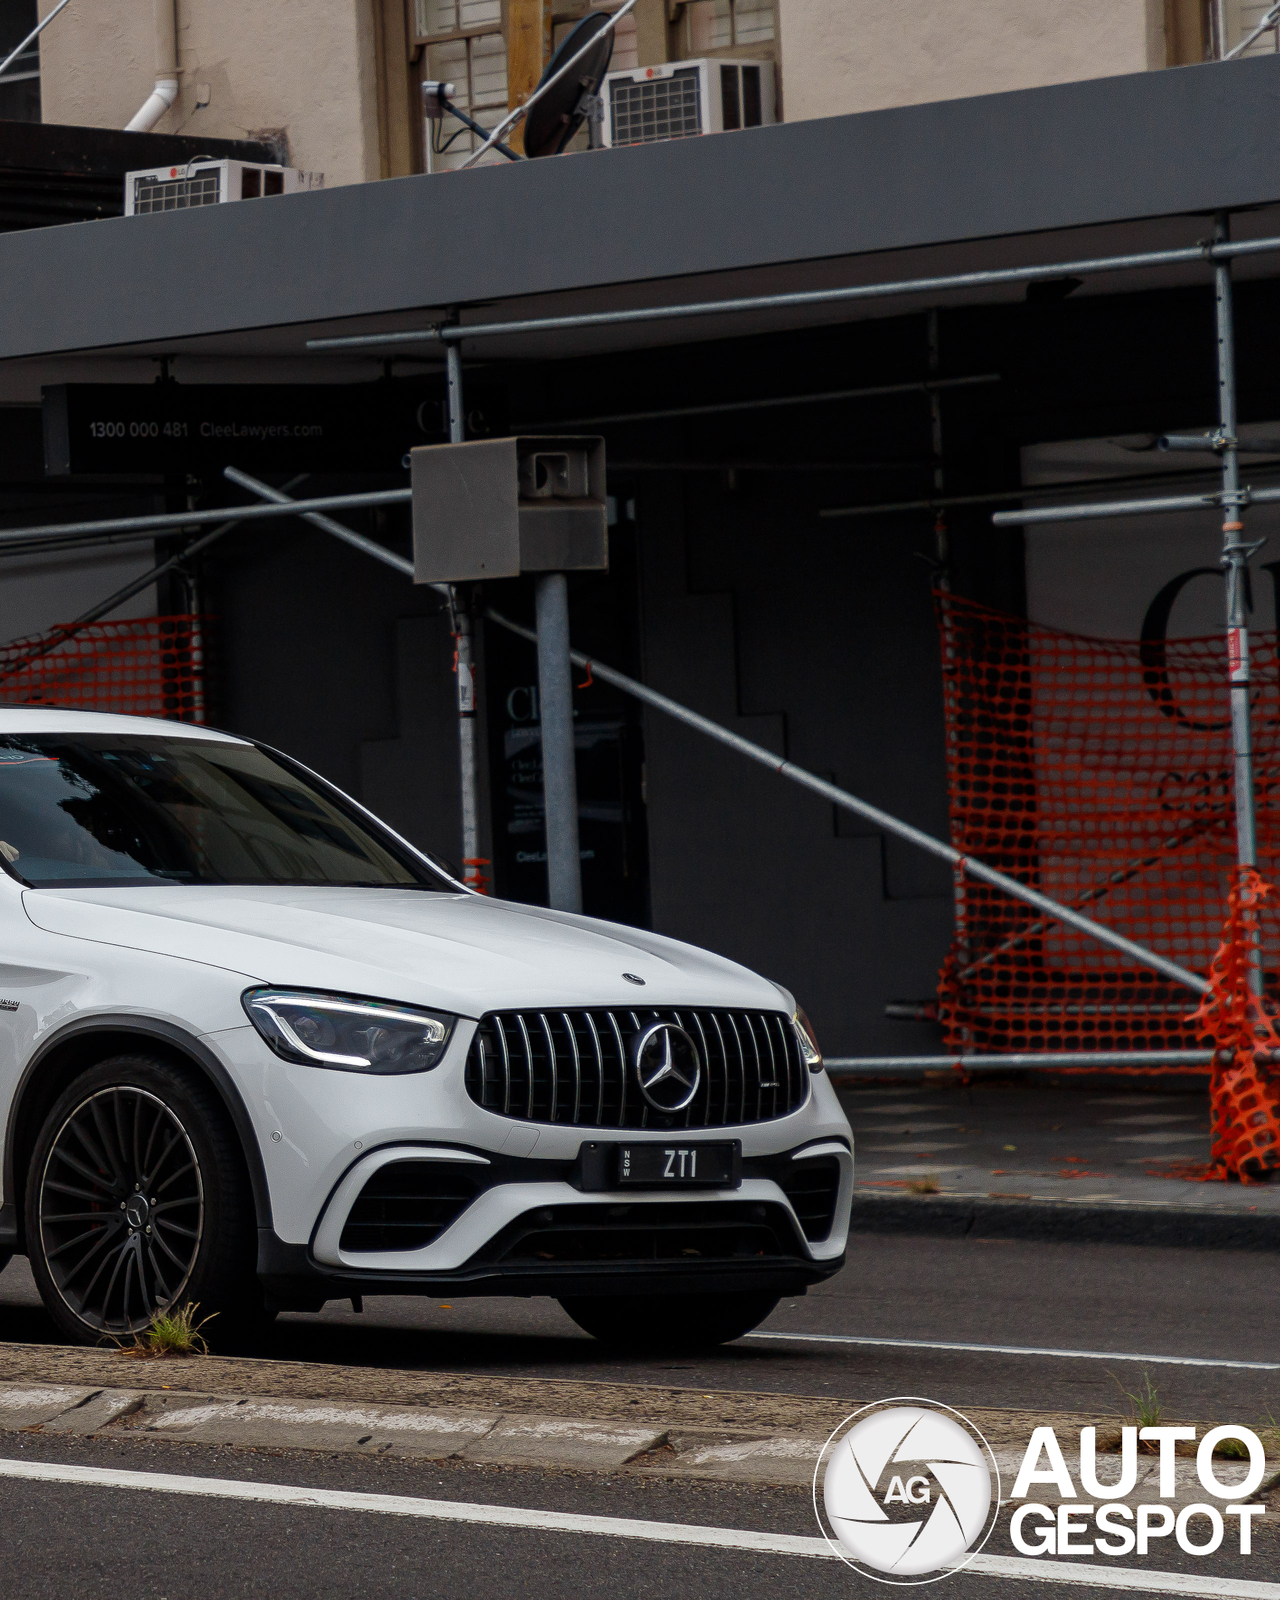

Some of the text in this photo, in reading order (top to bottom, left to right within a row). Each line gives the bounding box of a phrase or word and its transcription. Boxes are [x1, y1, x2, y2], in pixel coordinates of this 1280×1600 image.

[417, 399, 491, 434] Cle.
[89, 421, 323, 440] 1300 000 481 CleeLawyers.com
[663, 1150, 697, 1177] ZT1
